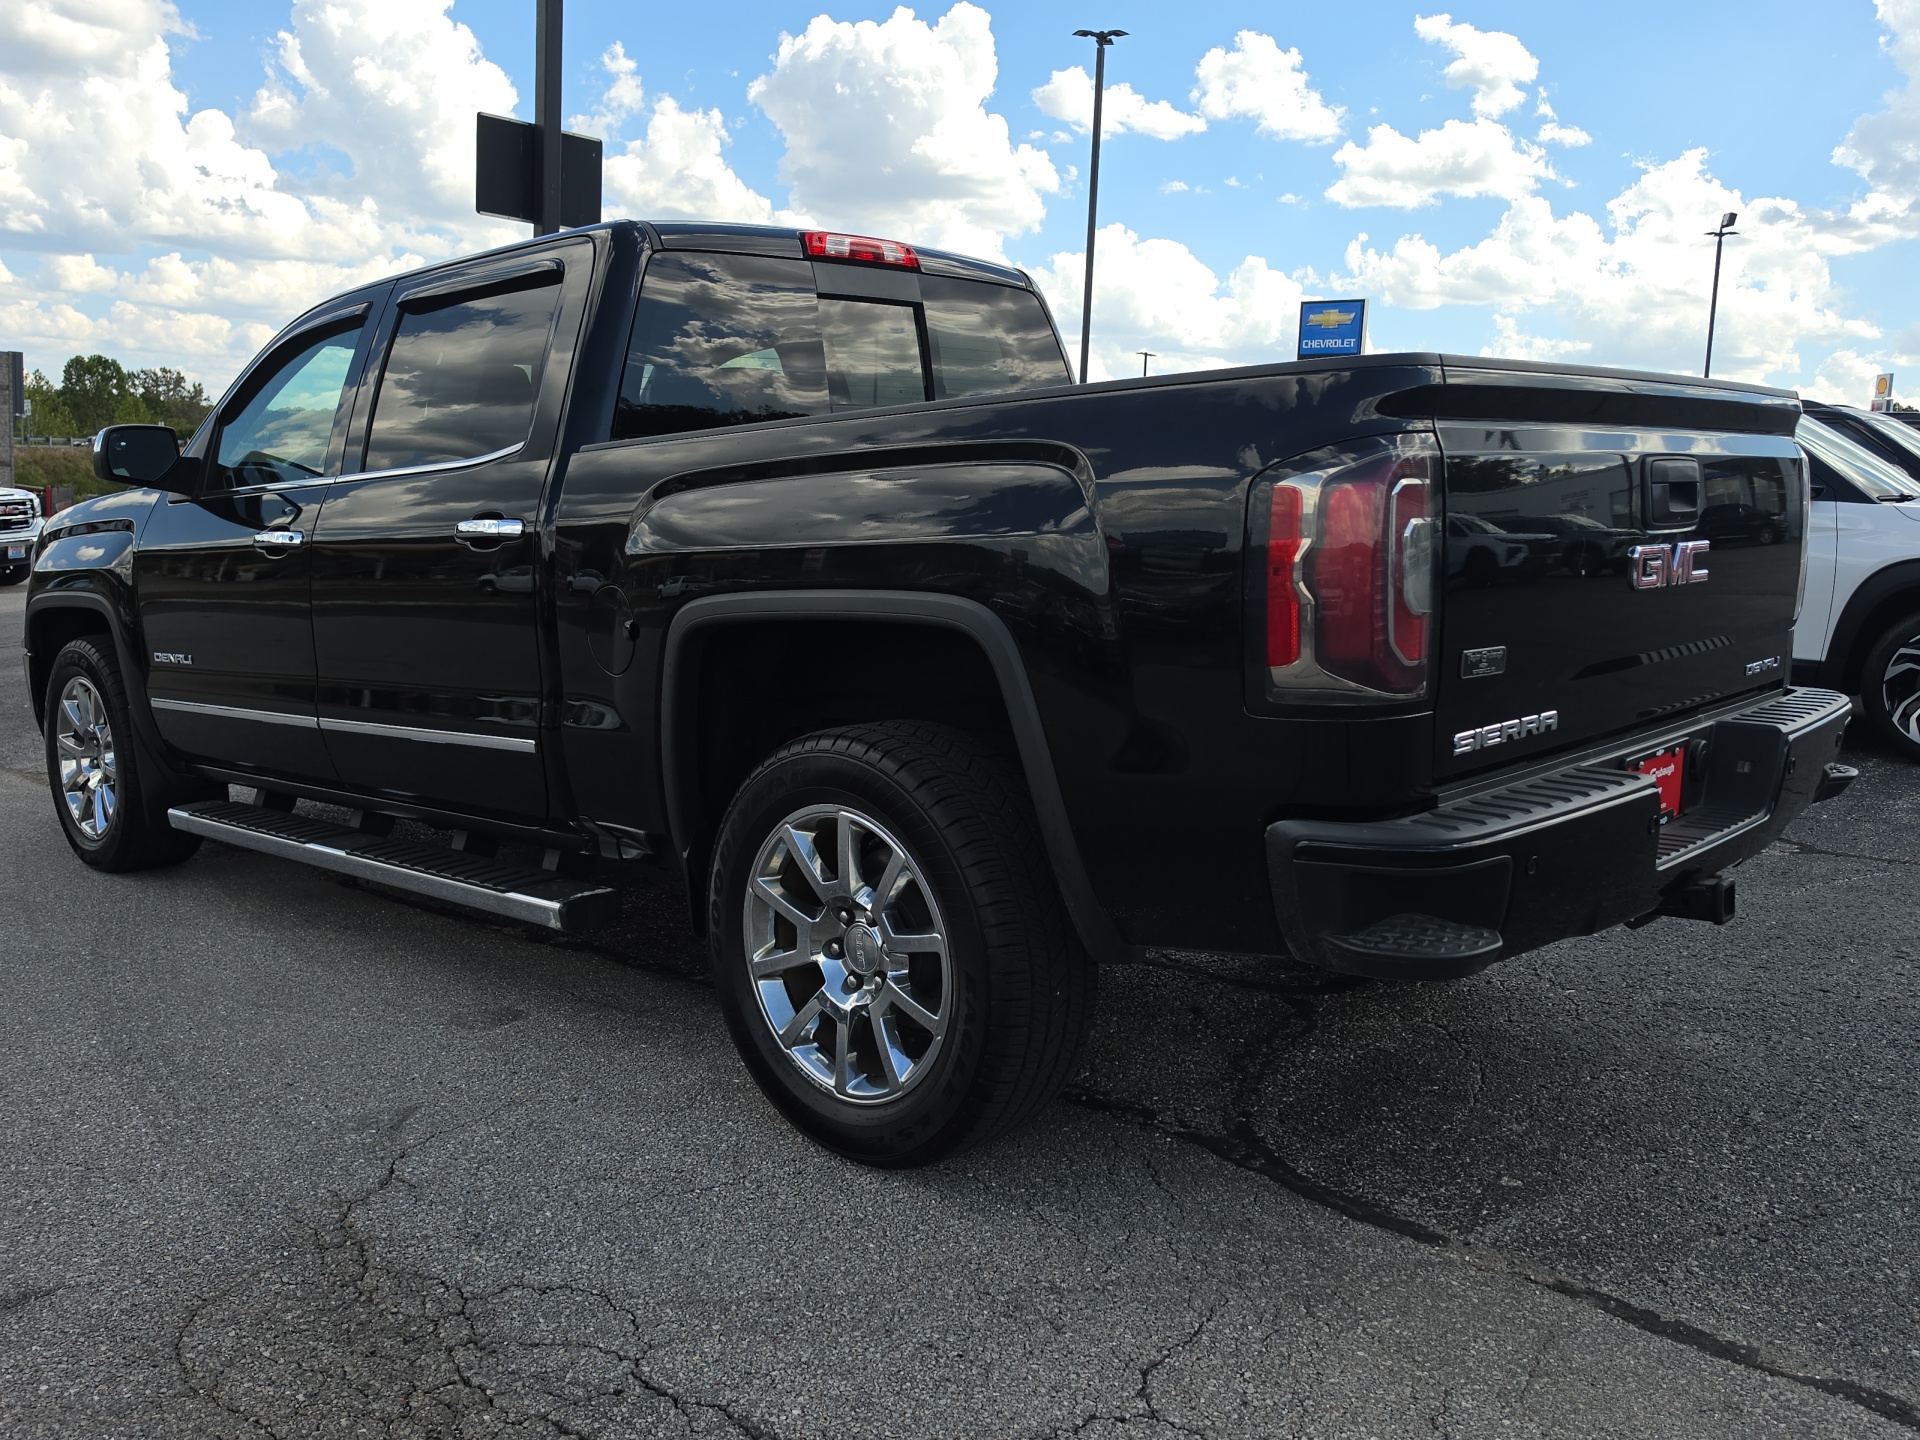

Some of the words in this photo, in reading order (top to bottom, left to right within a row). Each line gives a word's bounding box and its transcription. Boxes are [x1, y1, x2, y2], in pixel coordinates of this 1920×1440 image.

[1302, 338, 1356, 349] CHEVROLET
[1628, 539, 1710, 591] GMC
[152, 652, 193, 665] DENALI
[1745, 656, 1781, 676] DENALI
[1452, 710, 1559, 757] SIERRA
[1649, 763, 1675, 779] Grubaugh
